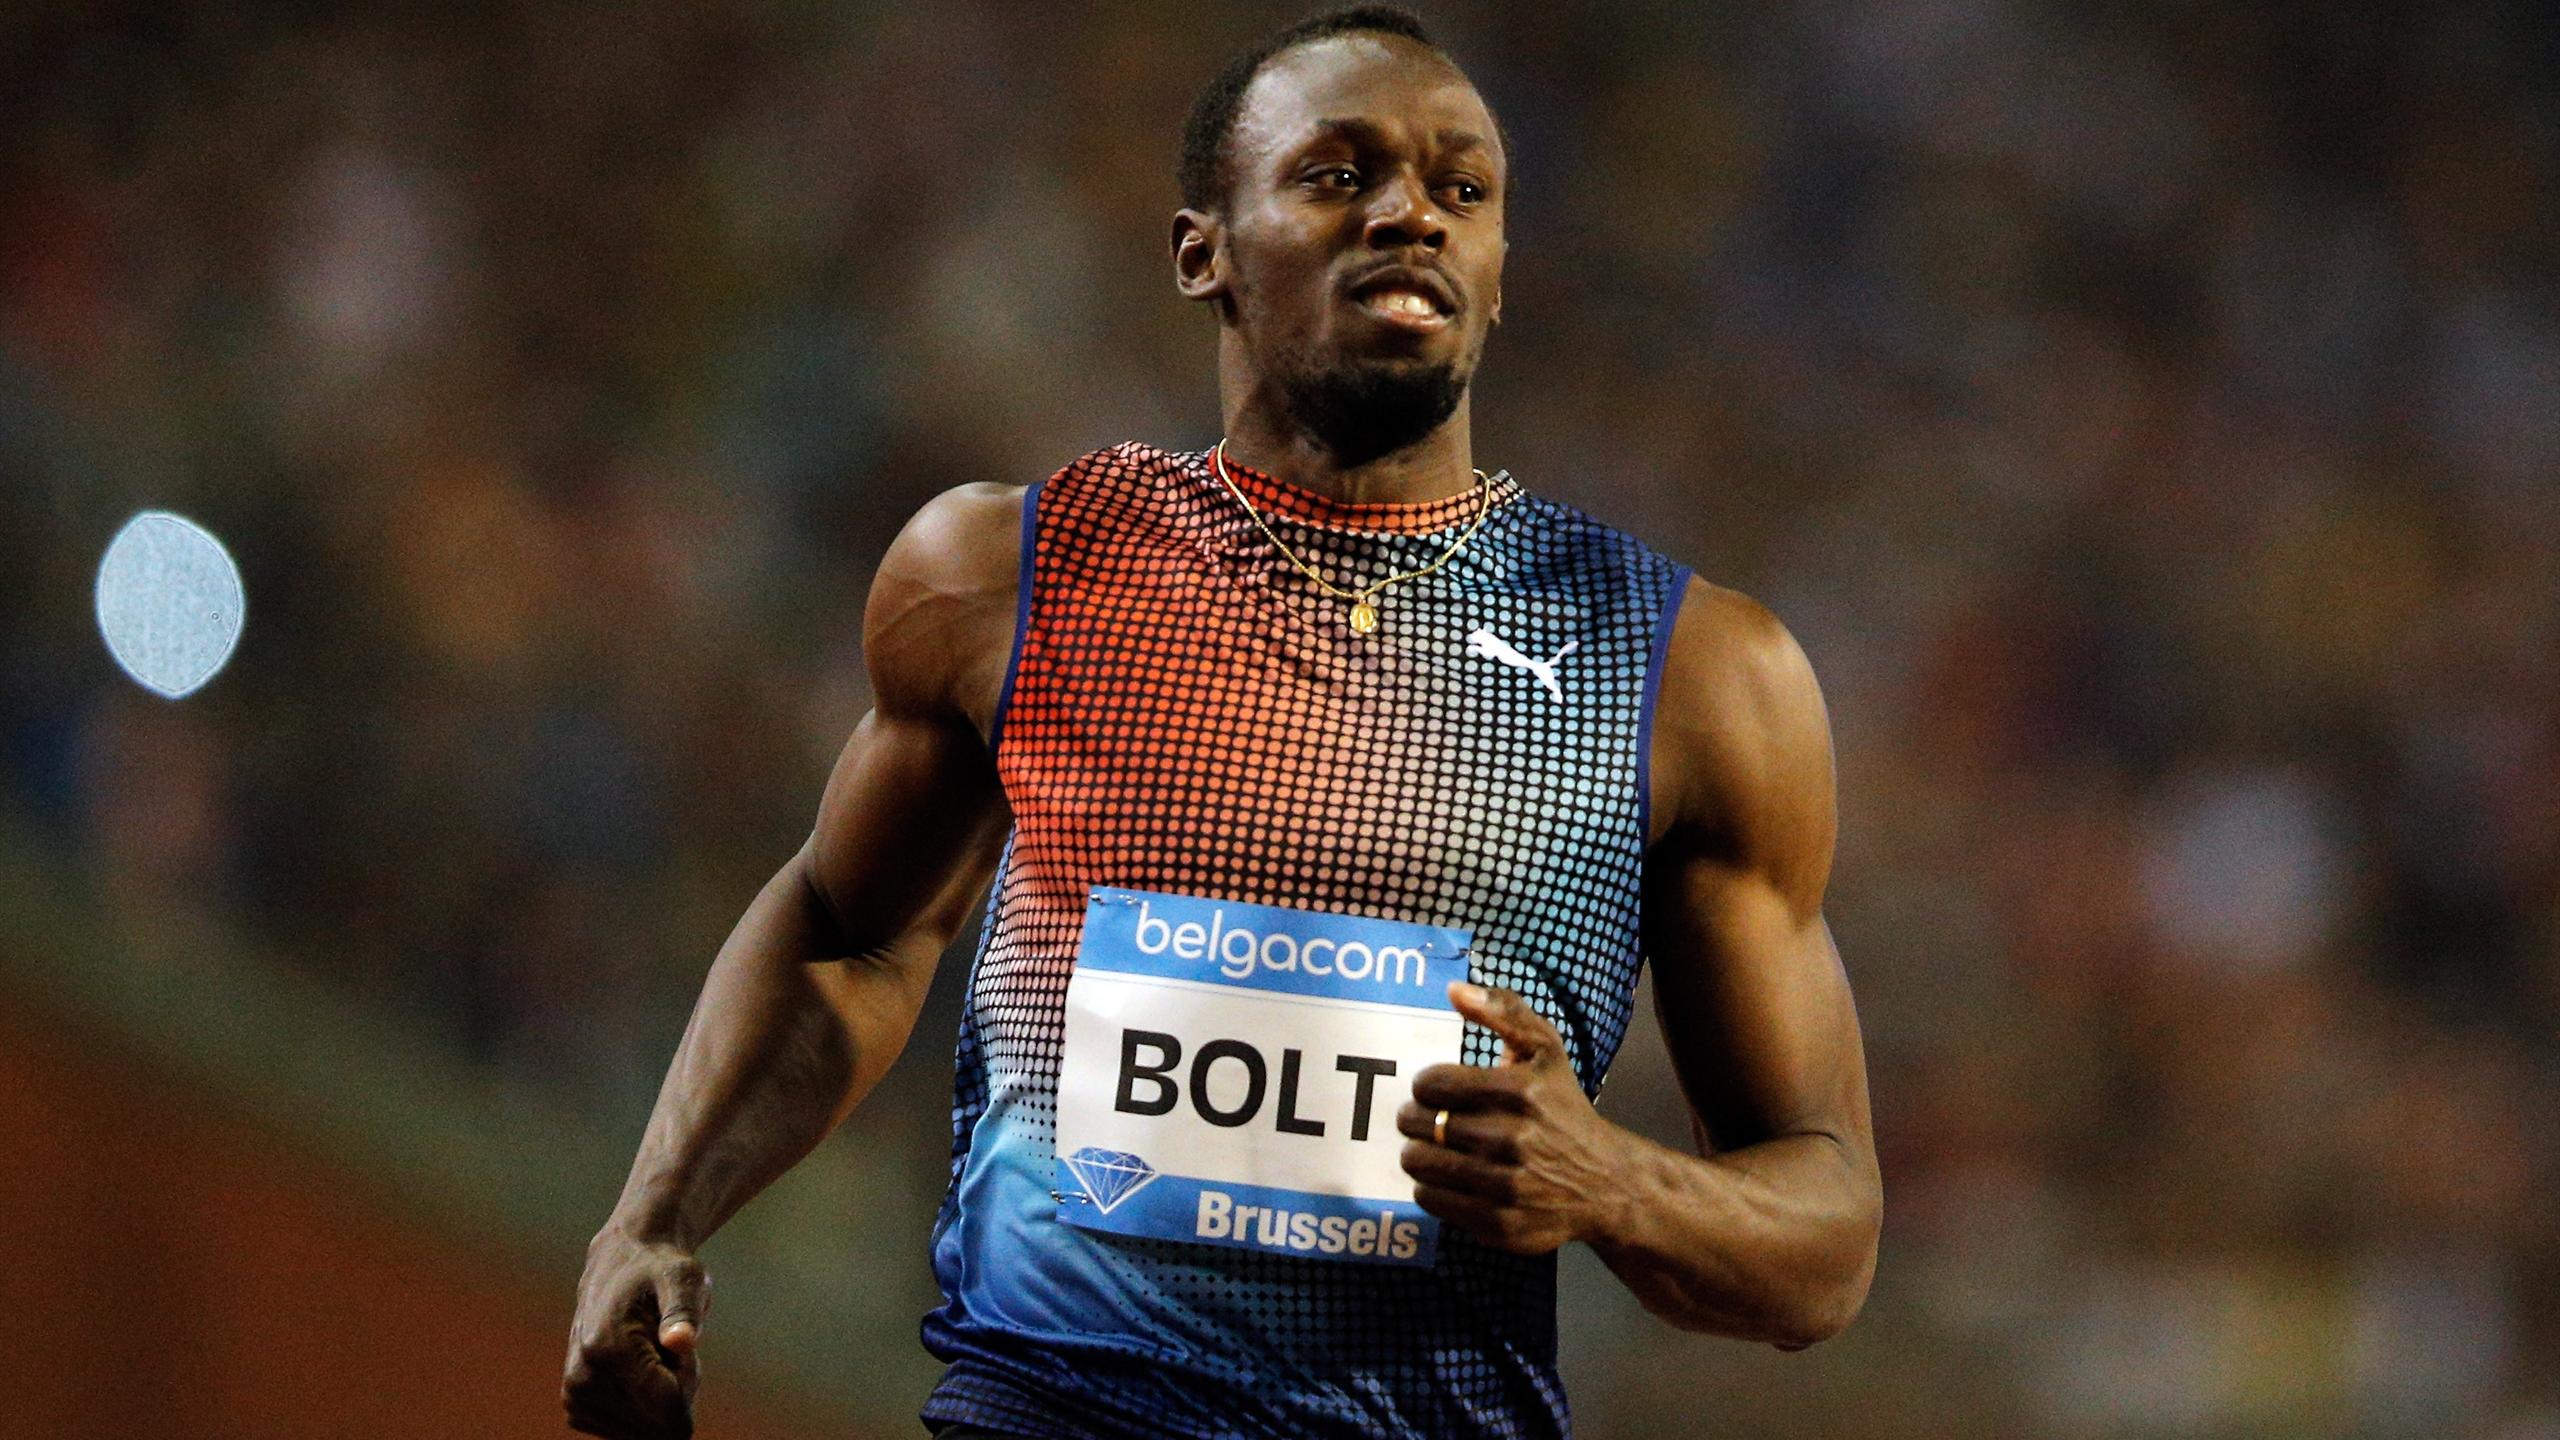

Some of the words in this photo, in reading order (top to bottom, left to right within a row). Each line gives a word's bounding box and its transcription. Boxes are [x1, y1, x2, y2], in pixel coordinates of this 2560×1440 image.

[1136, 901, 1427, 987] belgacom
[1114, 1028, 1397, 1142] BOLT
[1196, 1191, 1420, 1259] Brussels
